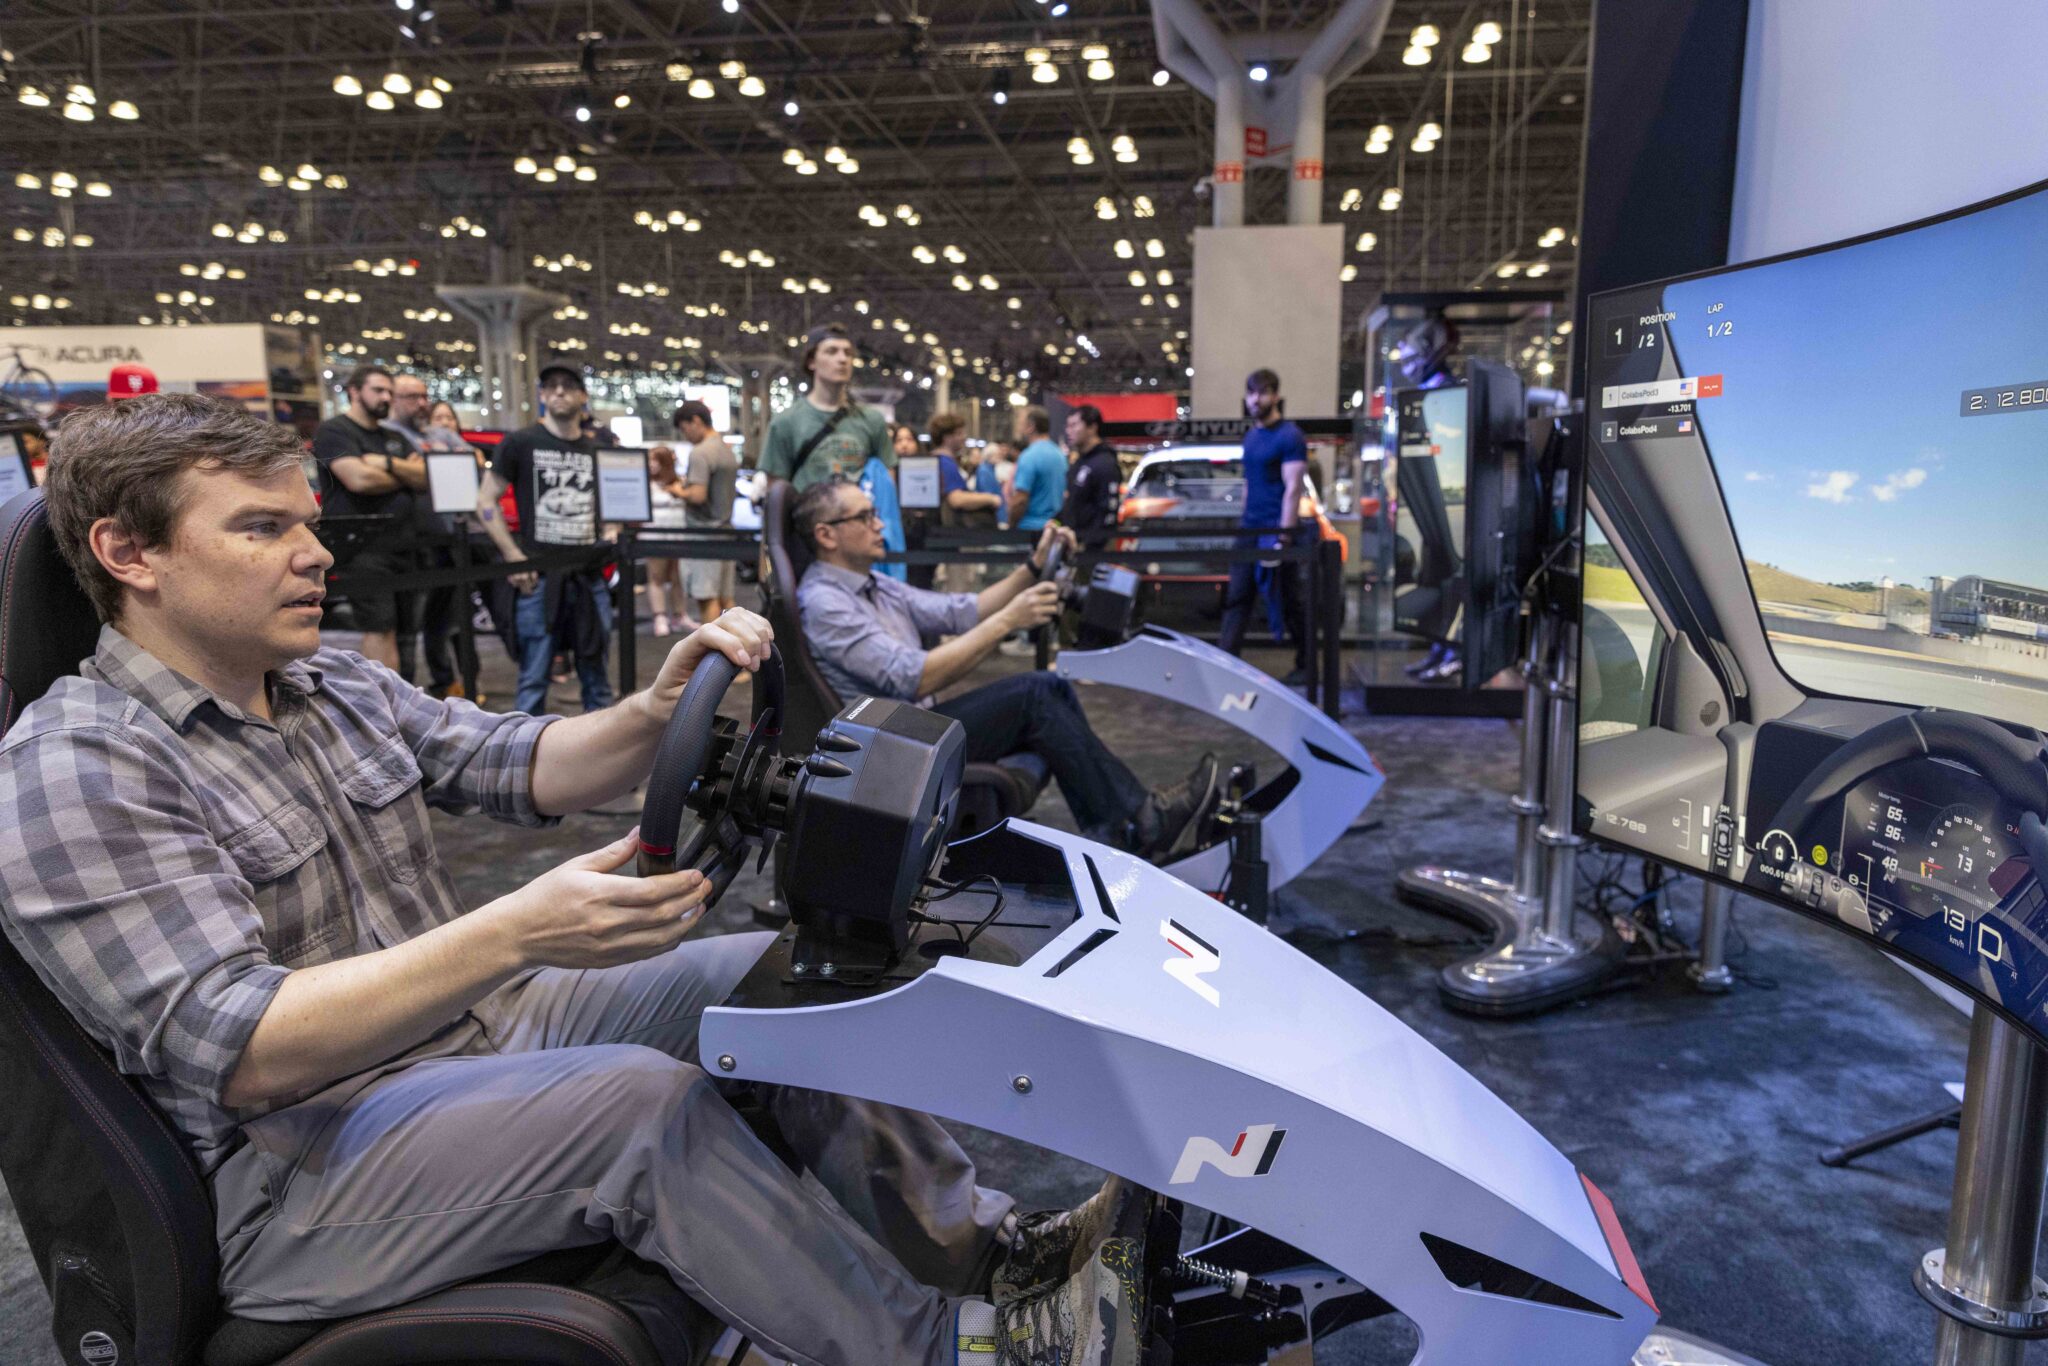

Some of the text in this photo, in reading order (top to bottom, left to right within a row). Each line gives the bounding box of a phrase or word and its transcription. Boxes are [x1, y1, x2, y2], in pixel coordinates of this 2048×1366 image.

[1707, 303, 1724, 313] LAP
[1640, 312, 1676, 326] POSITION
[1615, 328, 1622, 345] 1
[56, 346, 143, 362] ACURA
[1997, 386, 2048, 408] 12.80
[1606, 427, 1613, 437] 2
[1887, 805, 1903, 822] 65
[1953, 815, 1963, 824] 100
[1885, 824, 1902, 841] 96
[1881, 856, 1899, 872] 48
[1958, 853, 1973, 873] 13
[1943, 905, 1966, 932] 13
[1949, 935, 1965, 950] km/h
[1977, 922, 2003, 962] D
[2010, 970, 2018, 980] AT
